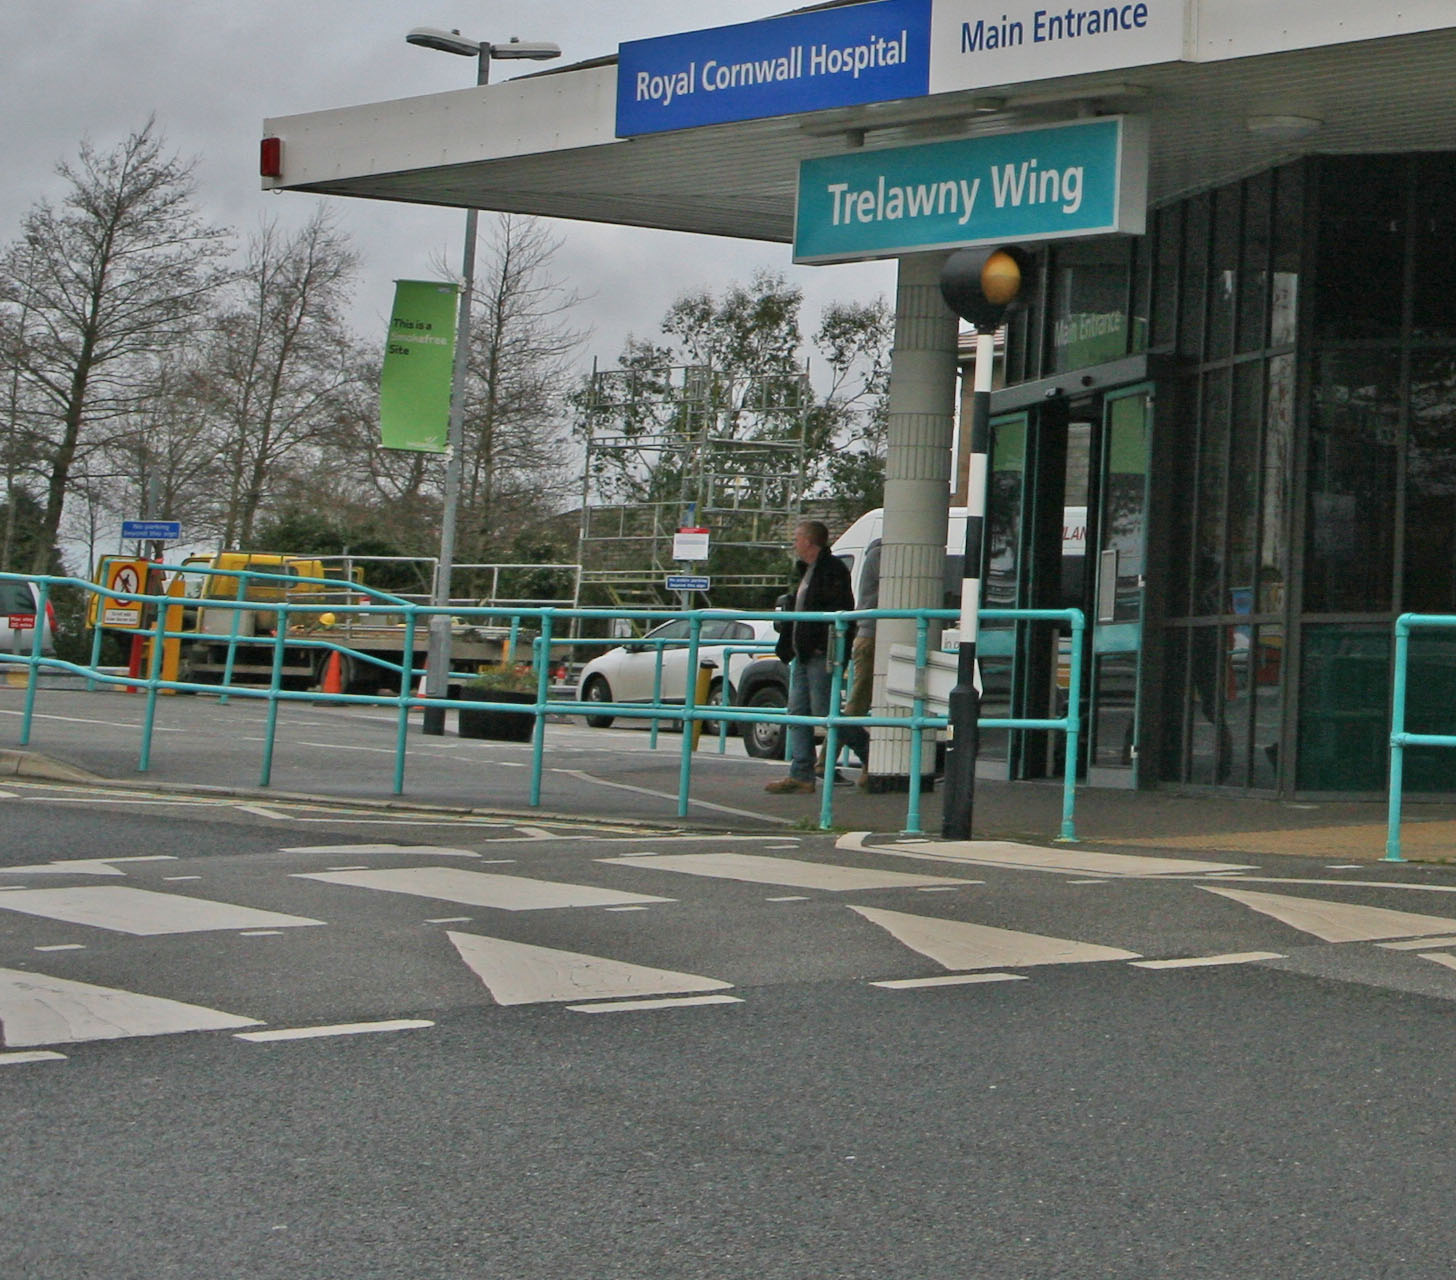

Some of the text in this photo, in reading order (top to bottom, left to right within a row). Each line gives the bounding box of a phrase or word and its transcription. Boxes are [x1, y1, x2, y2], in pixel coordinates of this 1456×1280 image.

[960, 0, 1149, 54] Main Entrance
[636, 28, 907, 107] Royal Cornwall Hospital
[828, 156, 1085, 227] Trelawny Wing
[389, 344, 409, 355] Site
[394, 318, 414, 329] This
[416, 321, 424, 330] is
